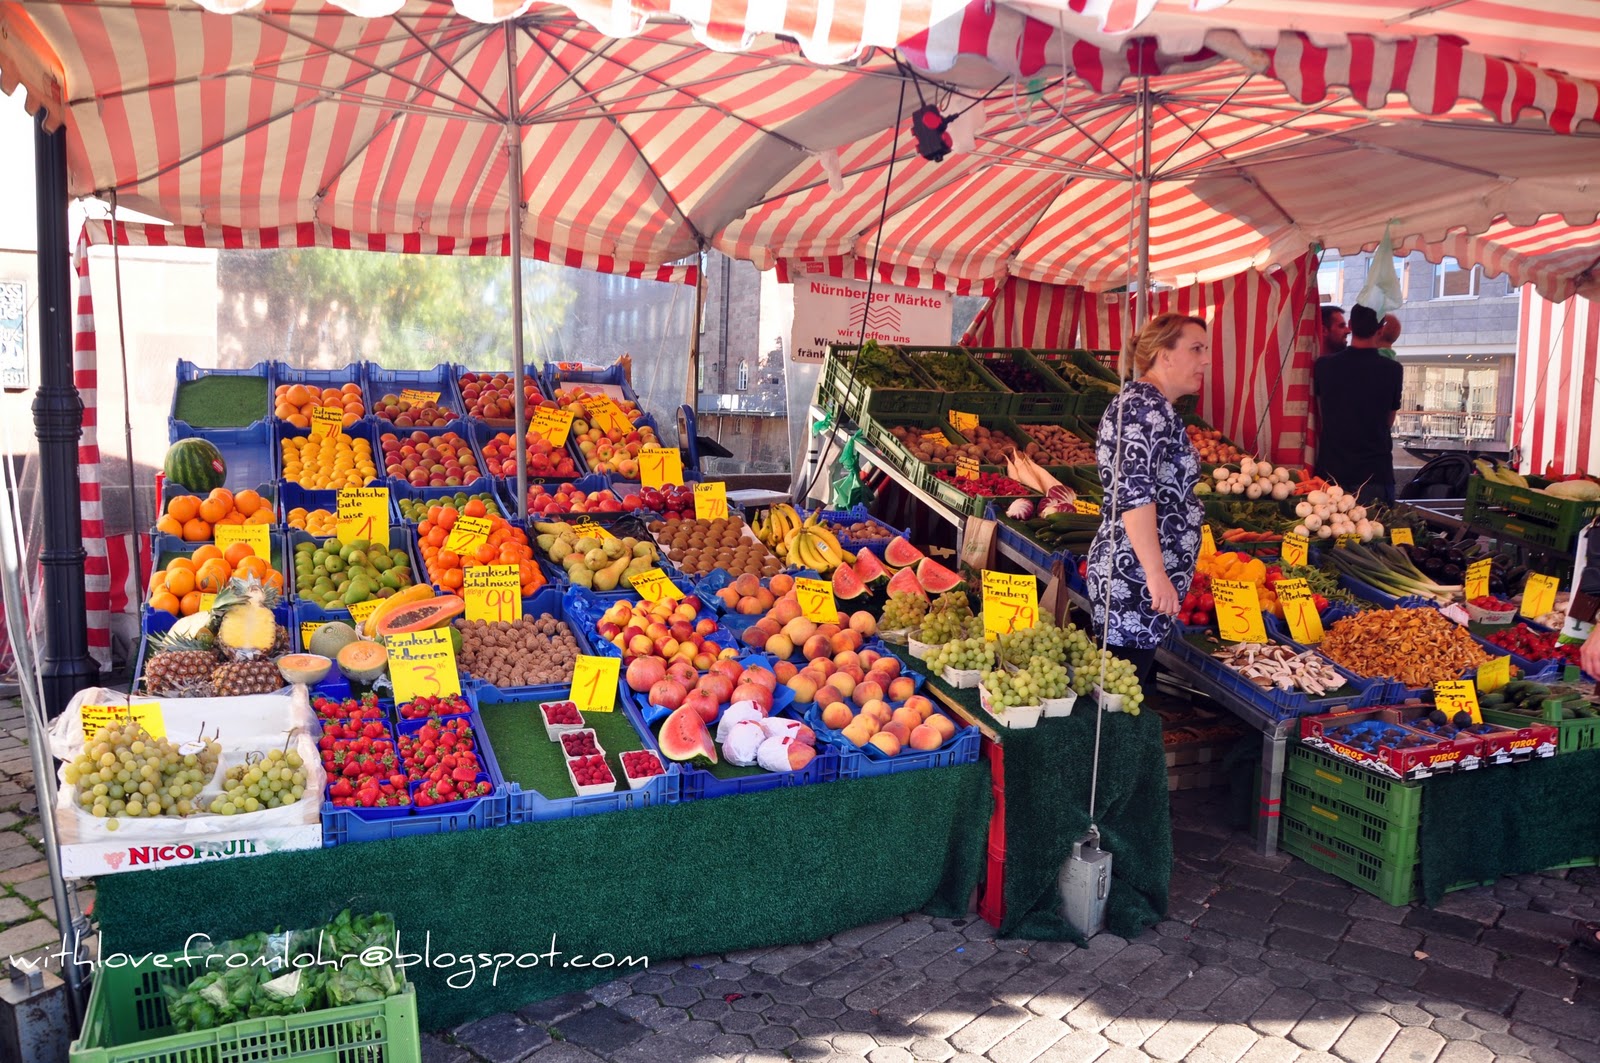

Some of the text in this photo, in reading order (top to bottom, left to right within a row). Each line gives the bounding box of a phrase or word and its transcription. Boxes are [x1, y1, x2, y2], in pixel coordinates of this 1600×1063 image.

[810, 281, 942, 309] Nürnberger Märkte
[814, 337, 833, 347] Wir
[838, 328, 854, 337] wir
[893, 332, 911, 343] uns
[652, 456, 665, 481] 1
[337, 498, 362, 508] Gute
[337, 509, 364, 519] Luise
[356, 516, 373, 541] 1
[453, 533, 476, 551] 2
[983, 570, 1035, 587] Kernlose
[983, 584, 1029, 604] Trauben
[811, 594, 825, 614] 2
[1000, 601, 1034, 634] 79
[1231, 605, 1250, 634] 3
[1296, 603, 1311, 640] 1
[387, 648, 448, 661] Erdbeeren
[412, 665, 441, 697] 3
[584, 668, 601, 705] 1
[1432, 681, 1466, 690] Frische
[1433, 689, 1467, 701] Feigen
[1451, 700, 1474, 717] 95
[1333, 743, 1364, 761] TOROS
[1509, 737, 1538, 749] TOROS
[1429, 750, 1461, 764] TOROS
